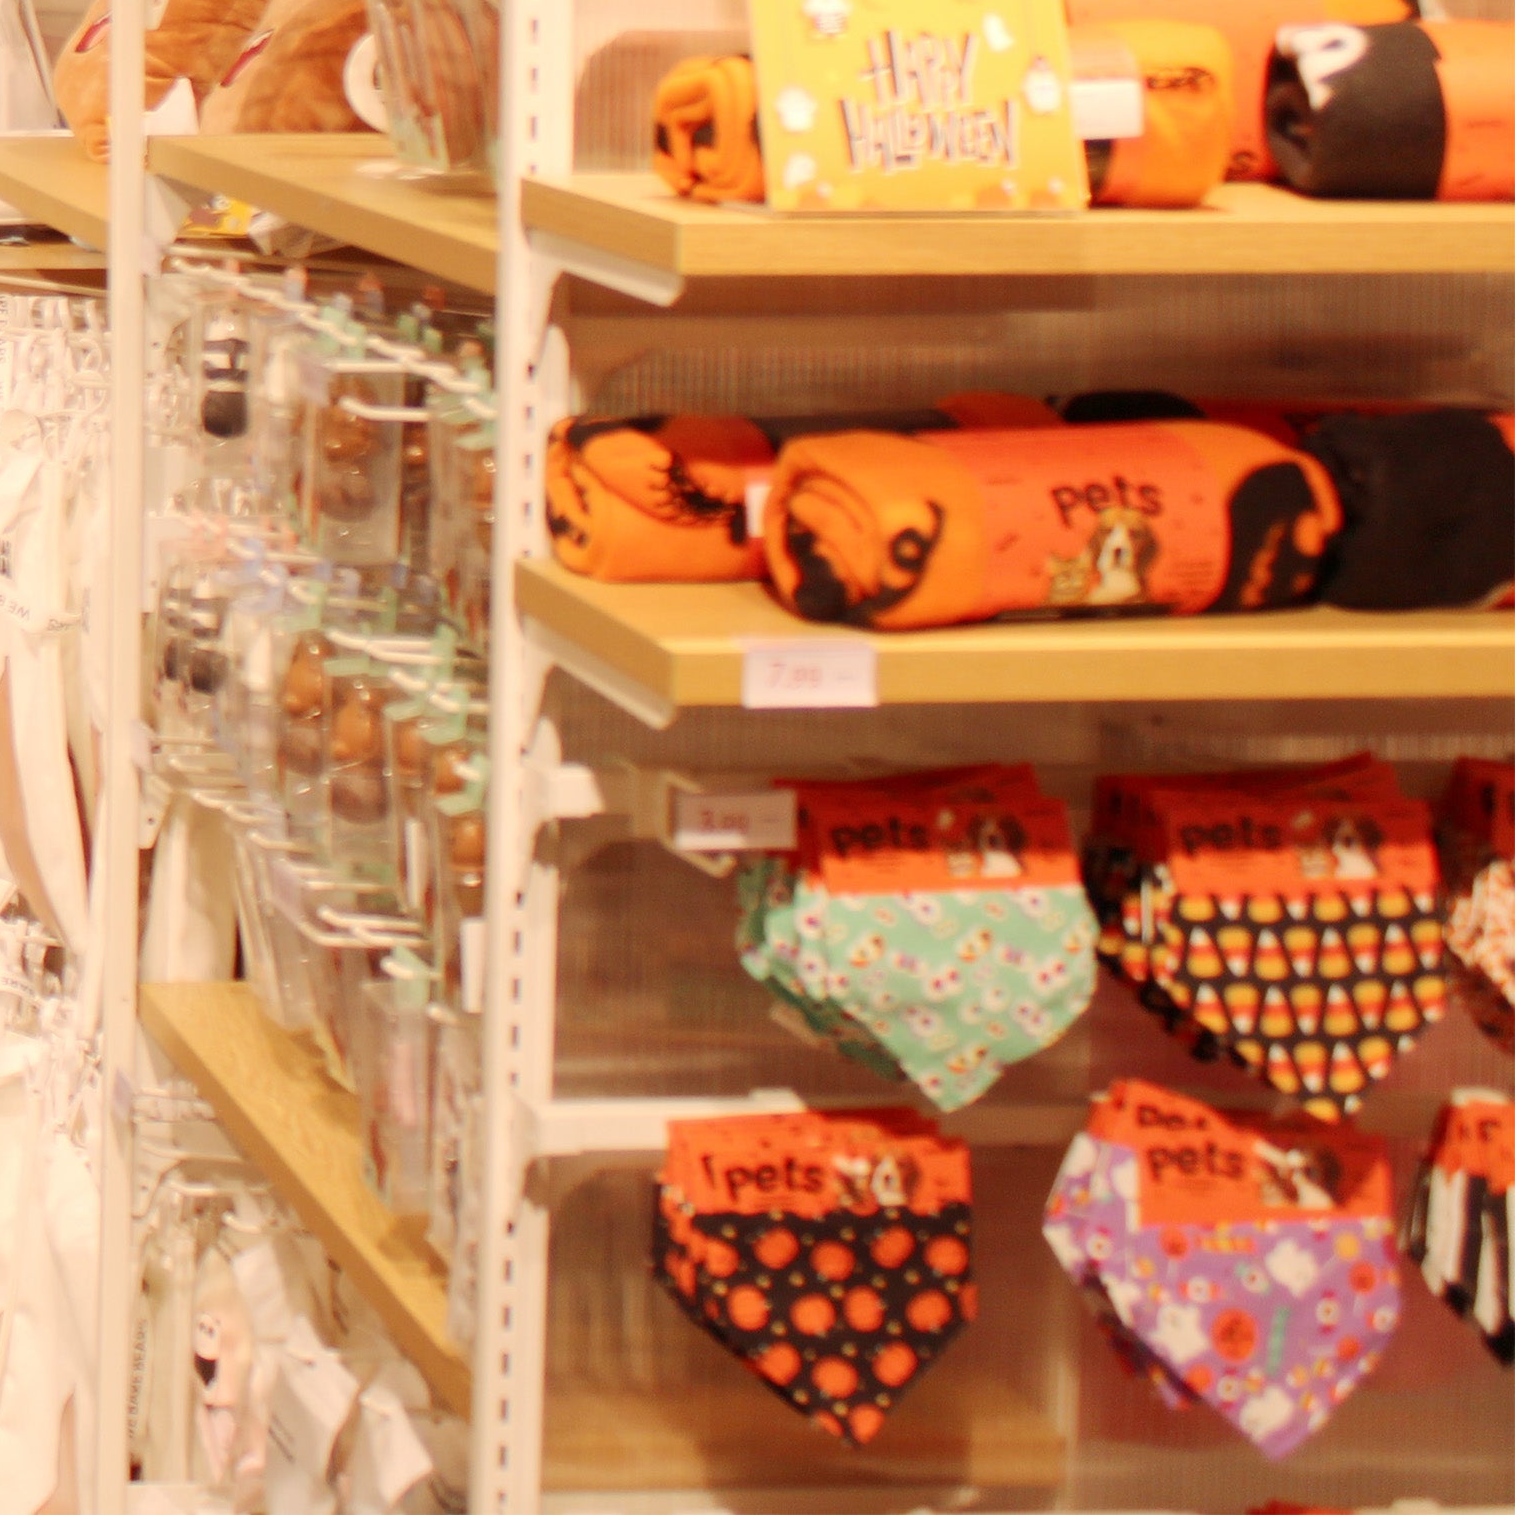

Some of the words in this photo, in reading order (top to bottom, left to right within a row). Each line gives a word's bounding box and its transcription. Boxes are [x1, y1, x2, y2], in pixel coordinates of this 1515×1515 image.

[858, 29, 978, 110] HAPPY
[837, 97, 1020, 175] HALLOWEEN
[1052, 475, 1164, 529] pets
[831, 815, 929, 858] pets
[1179, 815, 1281, 858] pets
[725, 1156, 824, 1202] pets
[1148, 1140, 1245, 1183] pets
